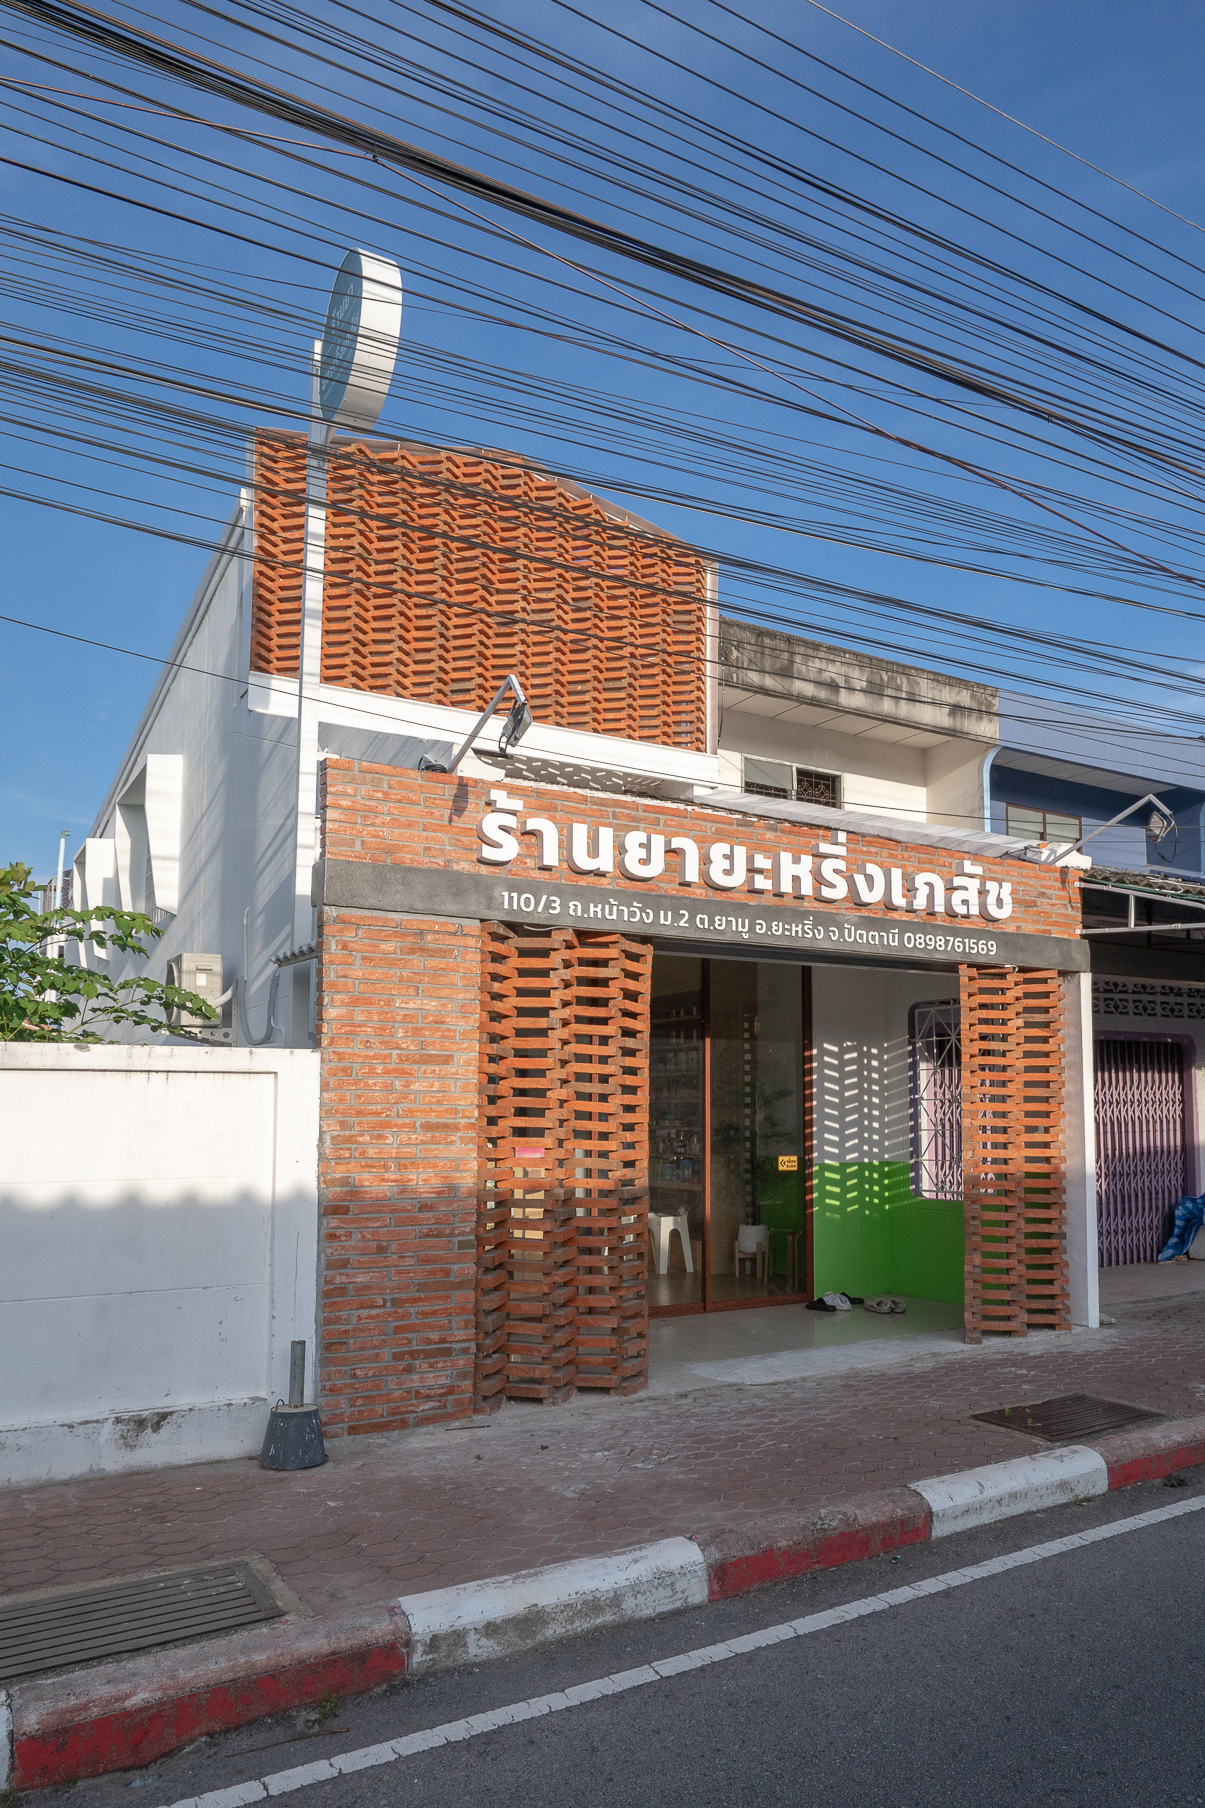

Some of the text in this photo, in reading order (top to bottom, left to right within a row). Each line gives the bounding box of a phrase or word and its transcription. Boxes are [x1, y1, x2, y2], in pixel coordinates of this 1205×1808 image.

[480, 788, 1013, 921] ร้านยายะหริ่งเภสัช
[501, 891, 997, 955] 110/3 ถ.หน้าวัง ม.2 ต.ยามู อ.ยะหริ่ง จ.ปัตตานี 0898761569
